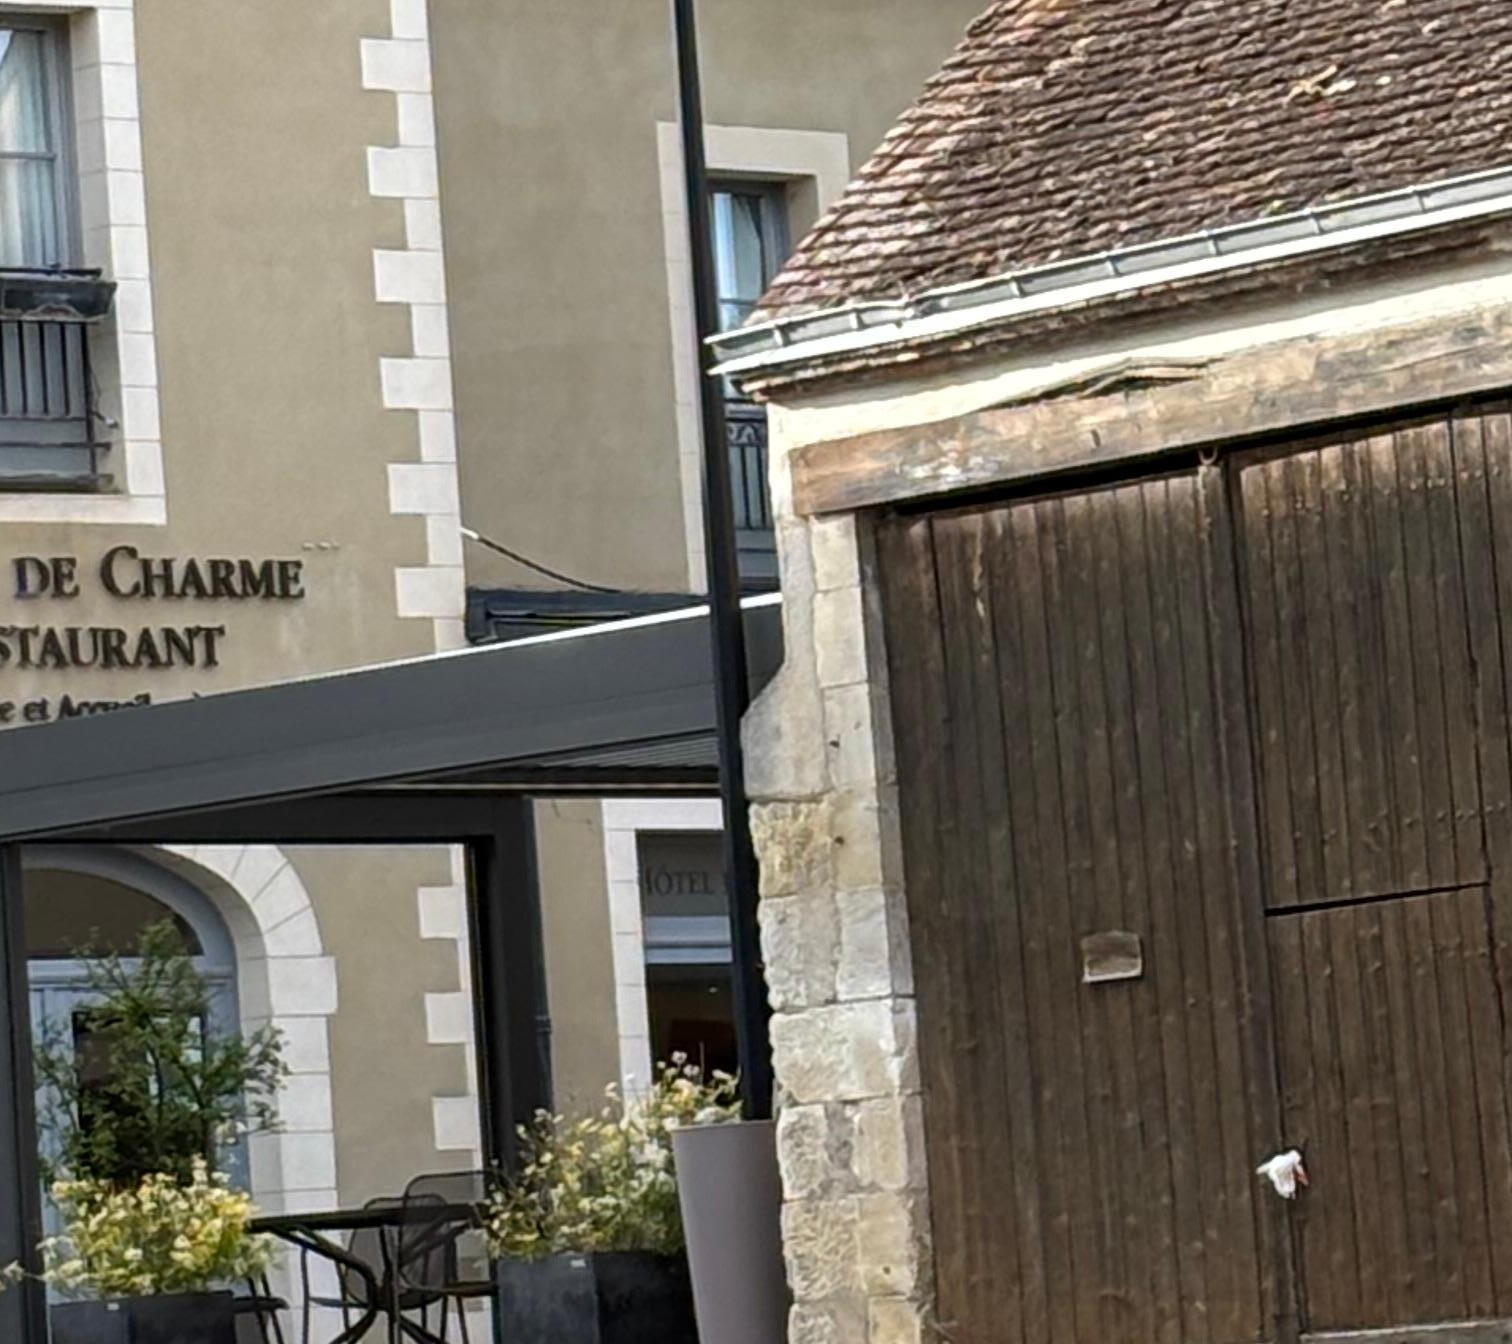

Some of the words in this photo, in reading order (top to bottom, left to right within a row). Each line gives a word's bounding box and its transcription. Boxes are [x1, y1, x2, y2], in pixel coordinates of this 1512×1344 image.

[14, 556, 81, 599] DE
[100, 544, 306, 600] CHARME
[22, 697, 49, 722] et
